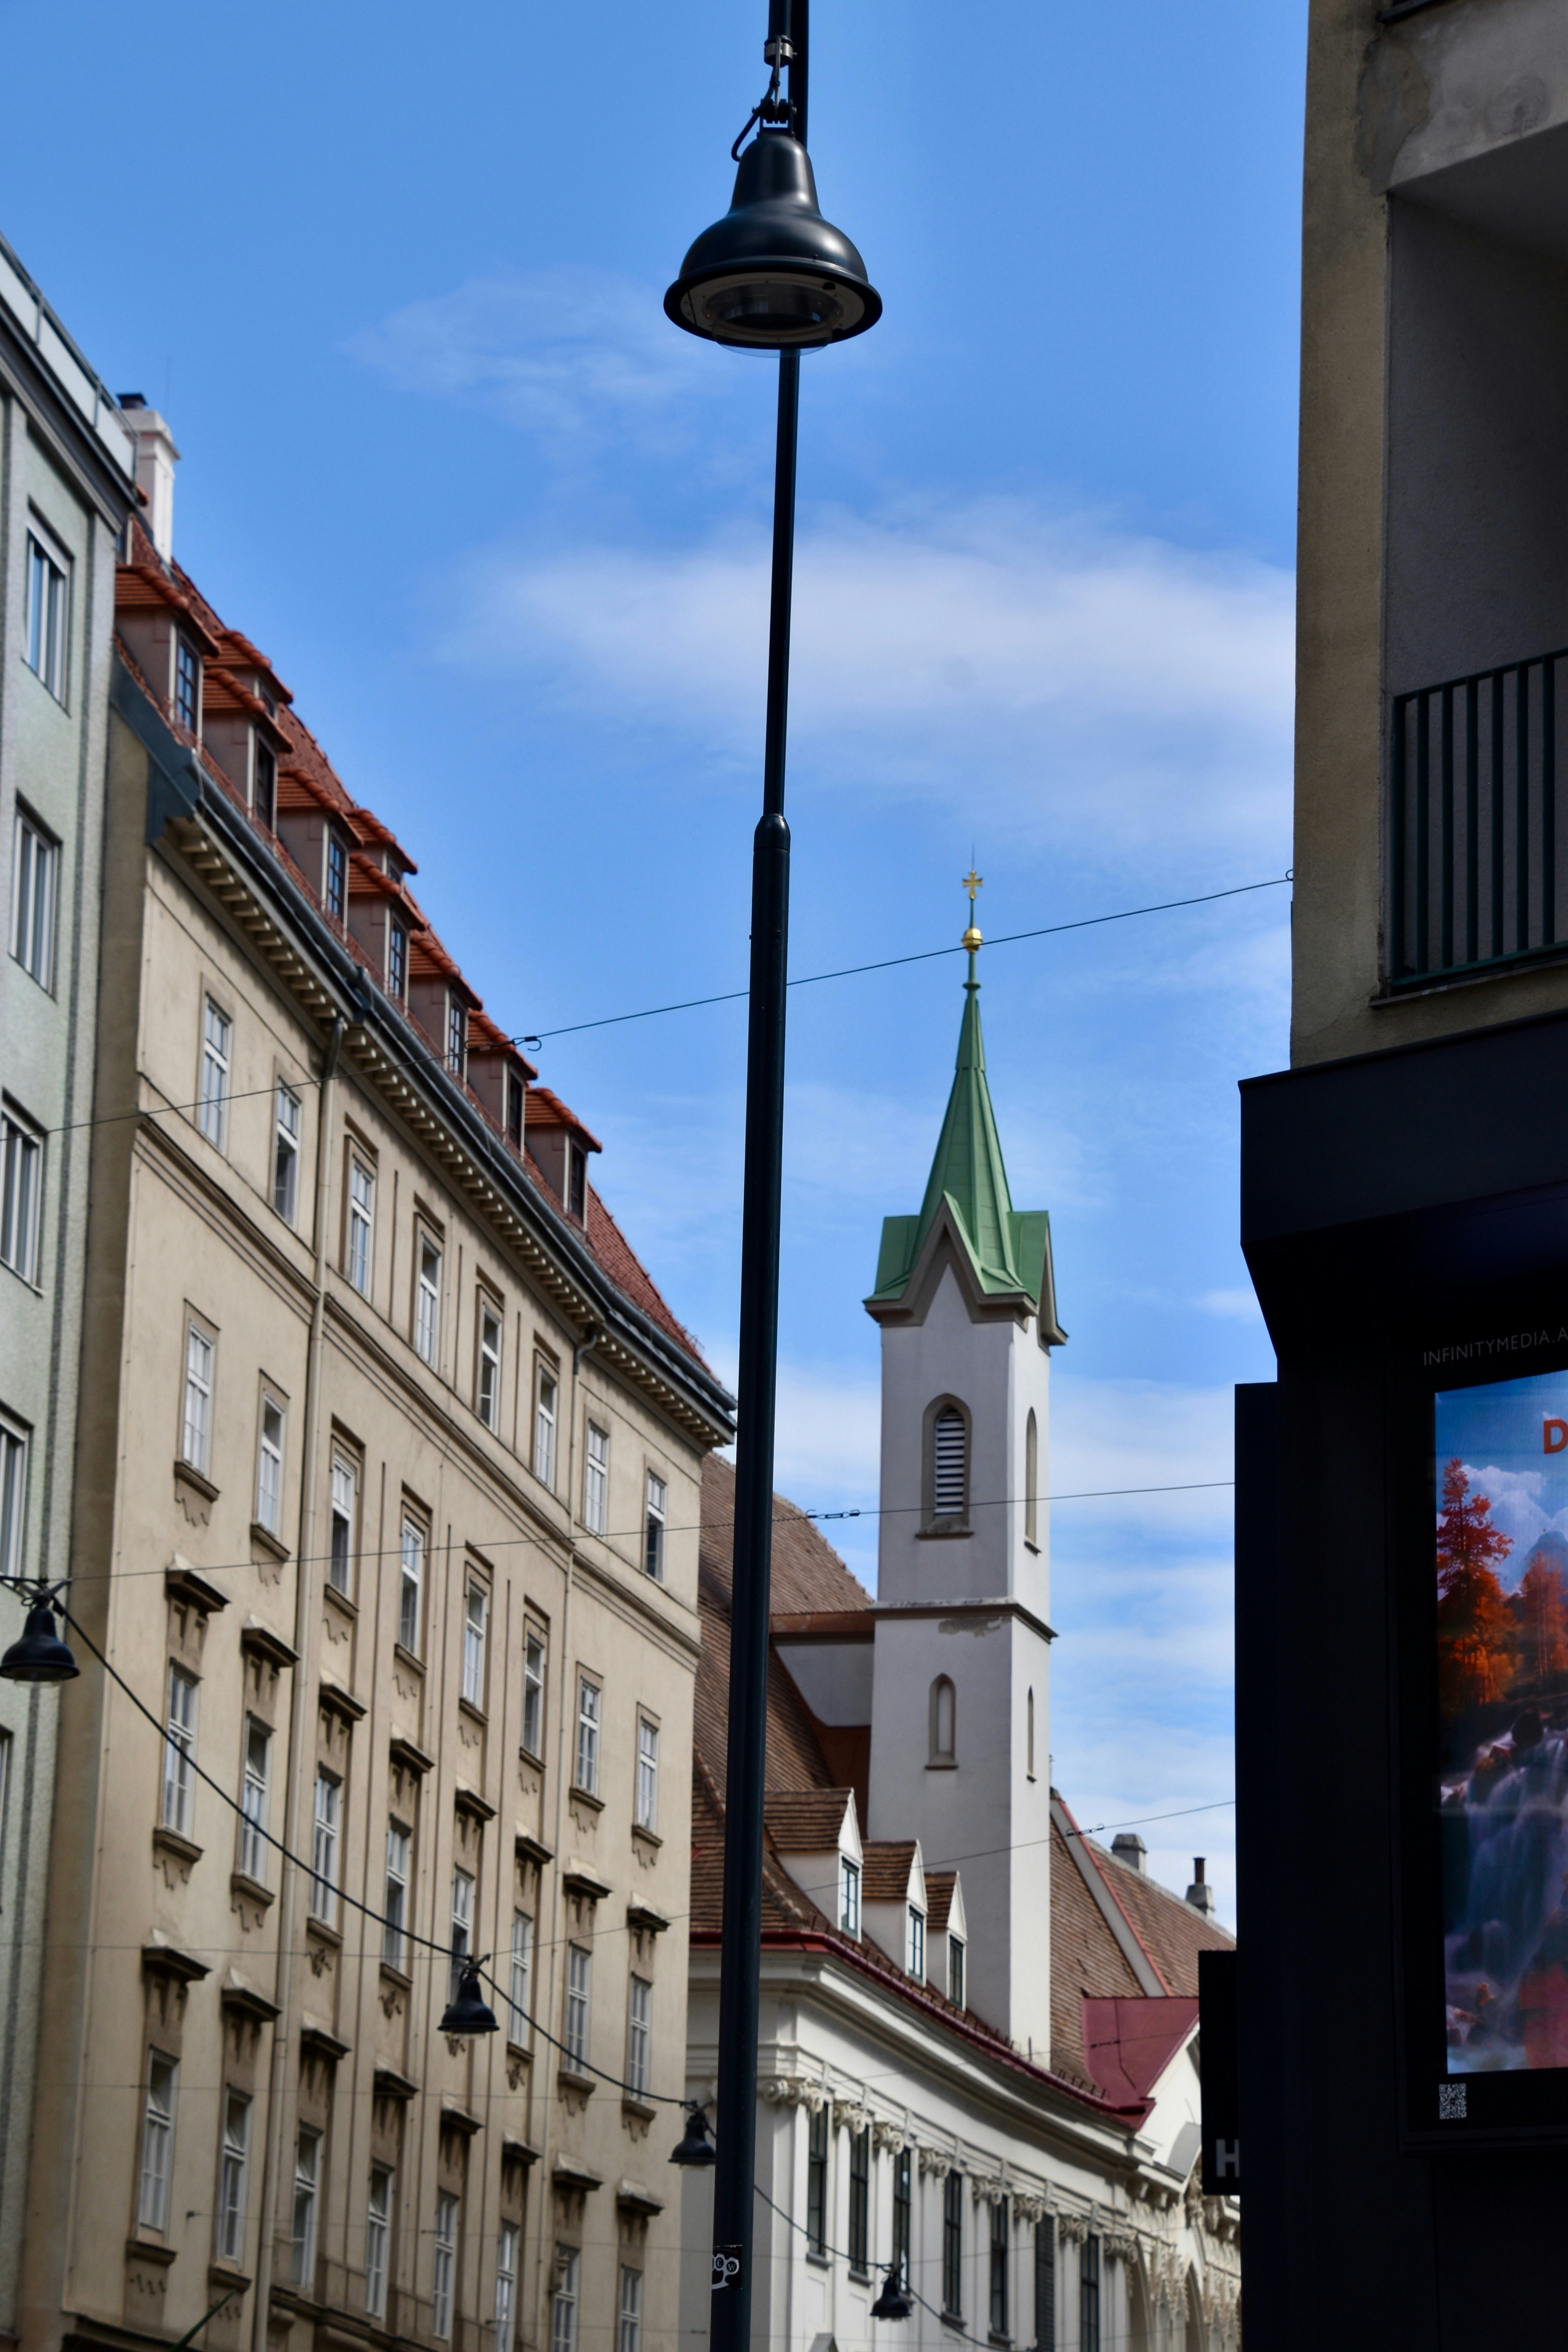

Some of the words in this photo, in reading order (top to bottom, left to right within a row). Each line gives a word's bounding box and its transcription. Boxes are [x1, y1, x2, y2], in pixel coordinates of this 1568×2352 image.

[1423, 1327, 1568, 1366] INFINITYMEDIA.A
[1543, 1419, 1568, 1454] D
[1216, 2138, 1240, 2178] H
